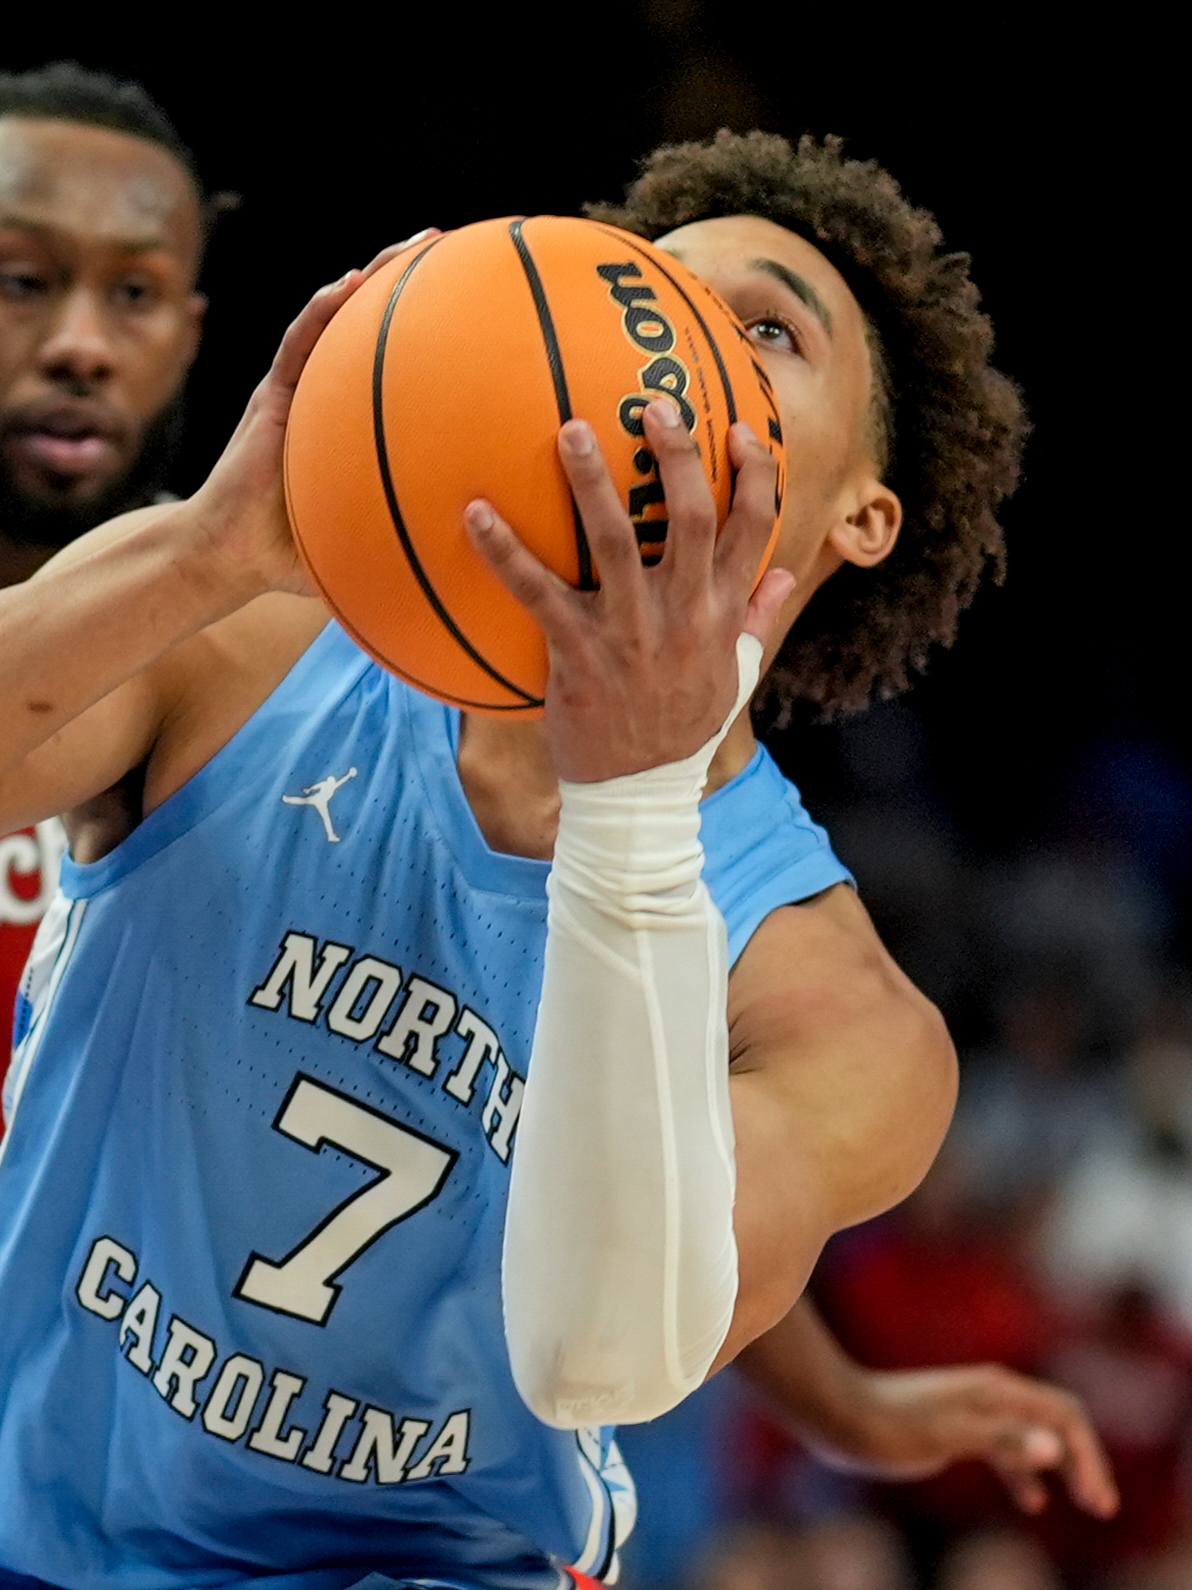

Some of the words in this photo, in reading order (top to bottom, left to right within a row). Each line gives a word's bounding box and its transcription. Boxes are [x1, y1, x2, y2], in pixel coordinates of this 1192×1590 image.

[248, 931, 526, 1167] NORTH
[232, 1071, 460, 1327] 7
[75, 1235, 472, 1486] CAROLINA
